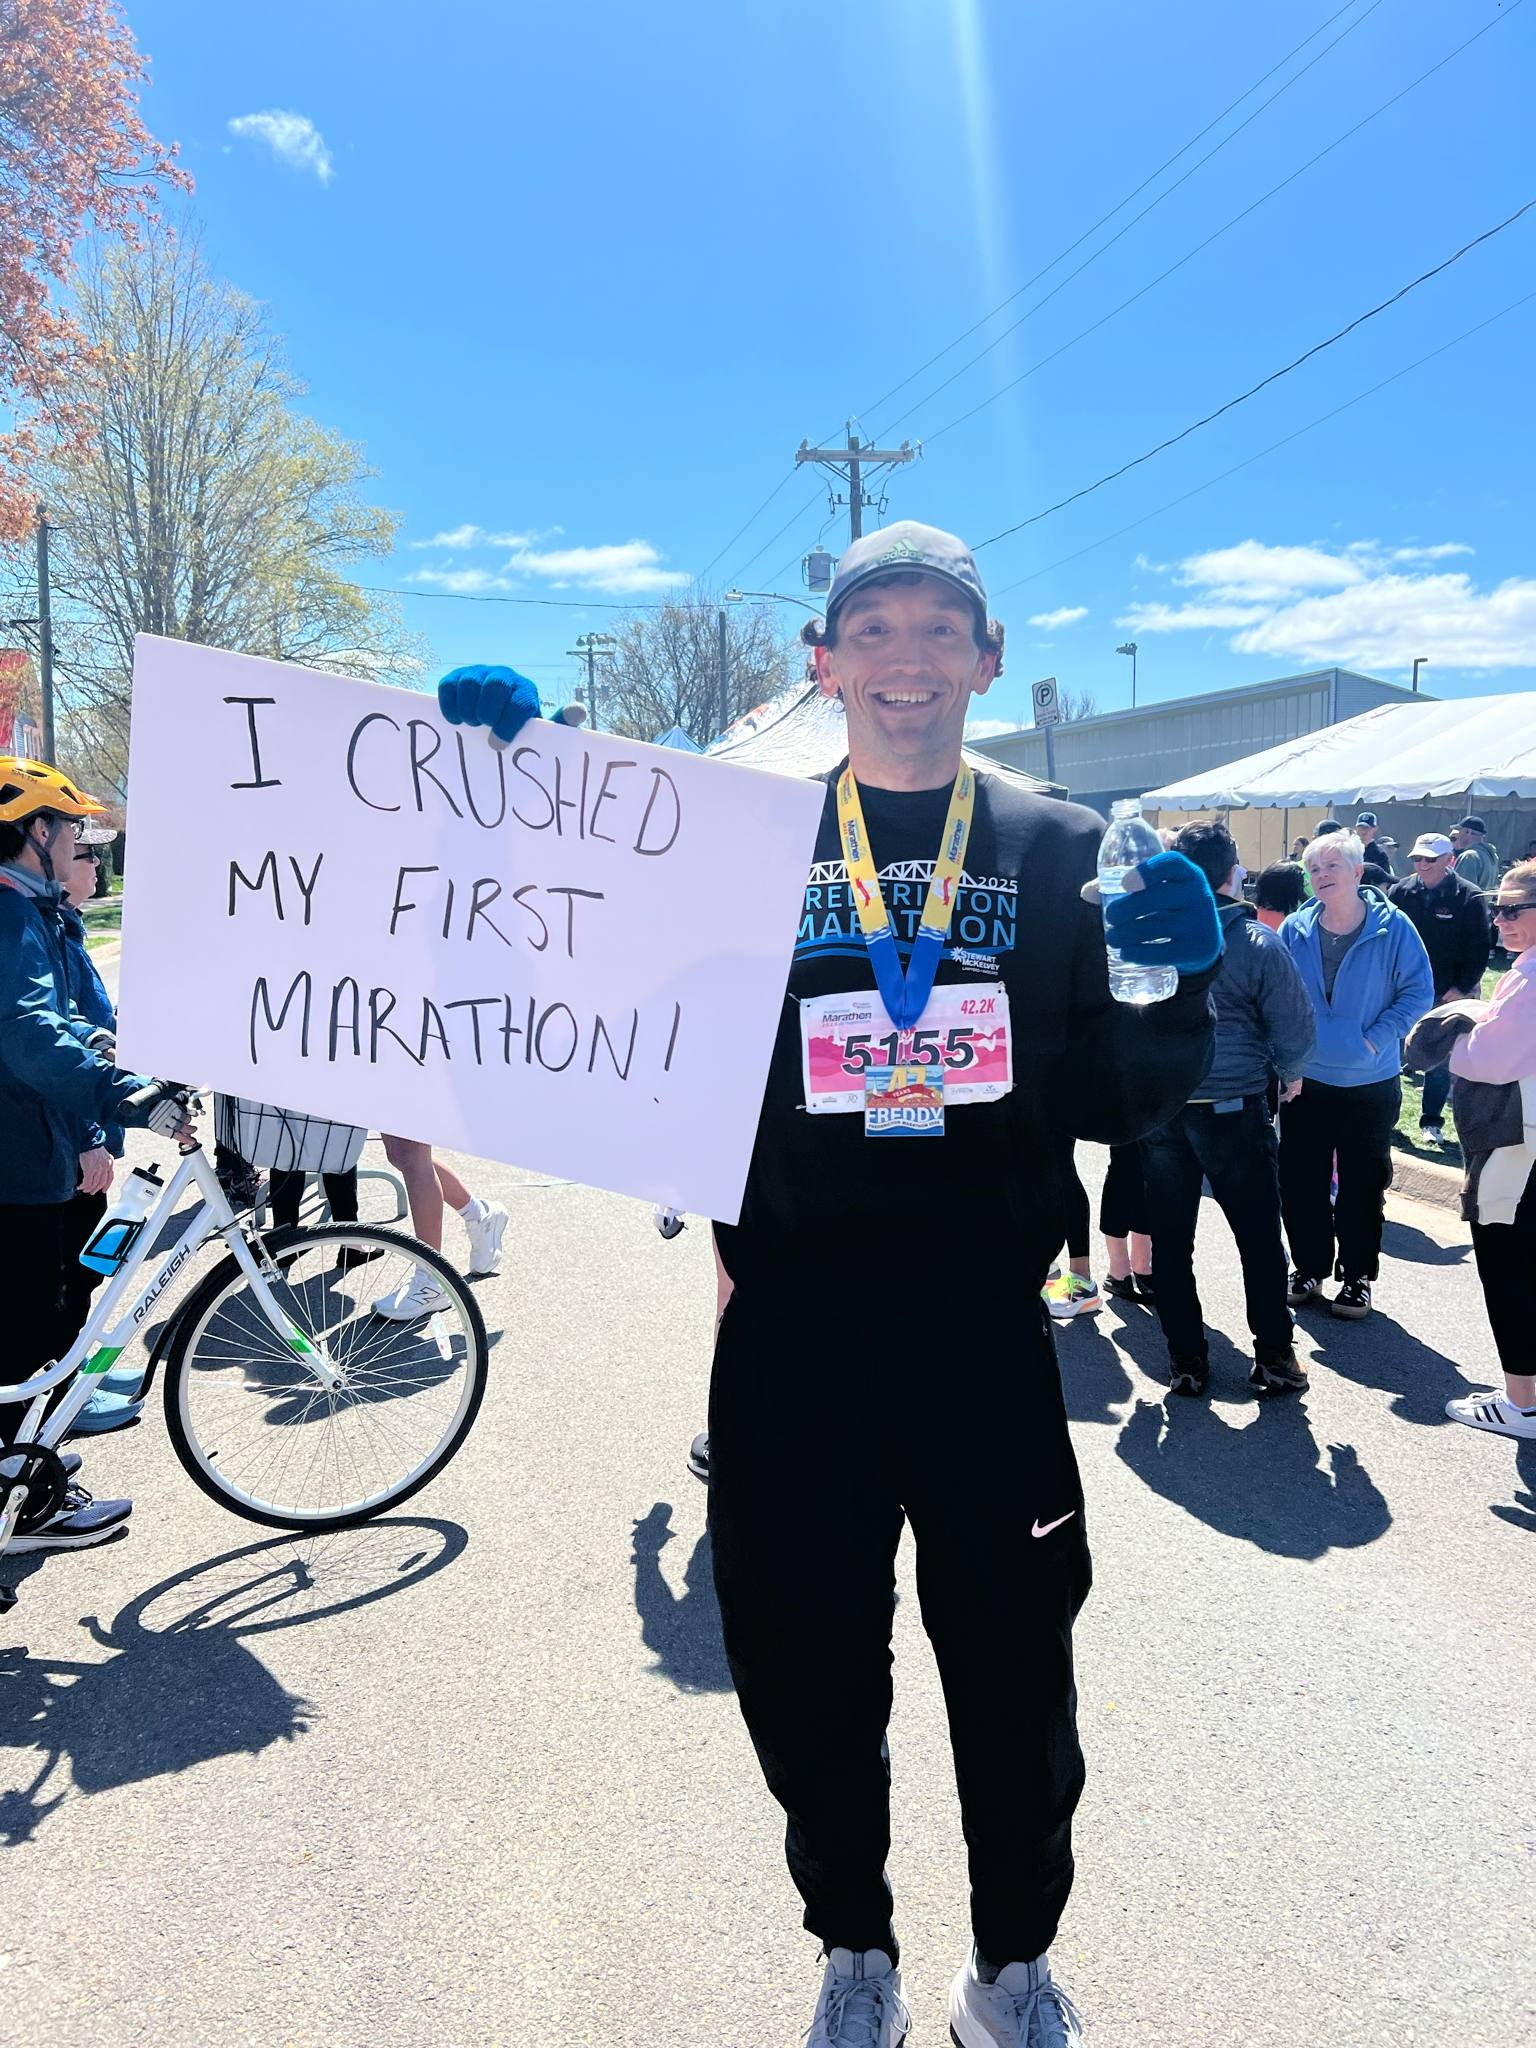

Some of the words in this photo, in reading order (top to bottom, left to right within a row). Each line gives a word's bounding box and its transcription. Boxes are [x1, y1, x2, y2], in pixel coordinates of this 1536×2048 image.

[223, 695, 283, 789] I
[346, 712, 681, 856] CRUSHED
[978, 876, 1018, 890] 2025
[228, 850, 324, 926] MY
[389, 865, 605, 958] FIRST
[960, 950, 997, 963] STEWART
[960, 998, 996, 1015] 42.2K
[822, 1012, 872, 1023] Marathon
[841, 1027, 974, 1075] 5155
[866, 1106, 943, 1124] FREDDY
[133, 1243, 191, 1325] RALEIGH
